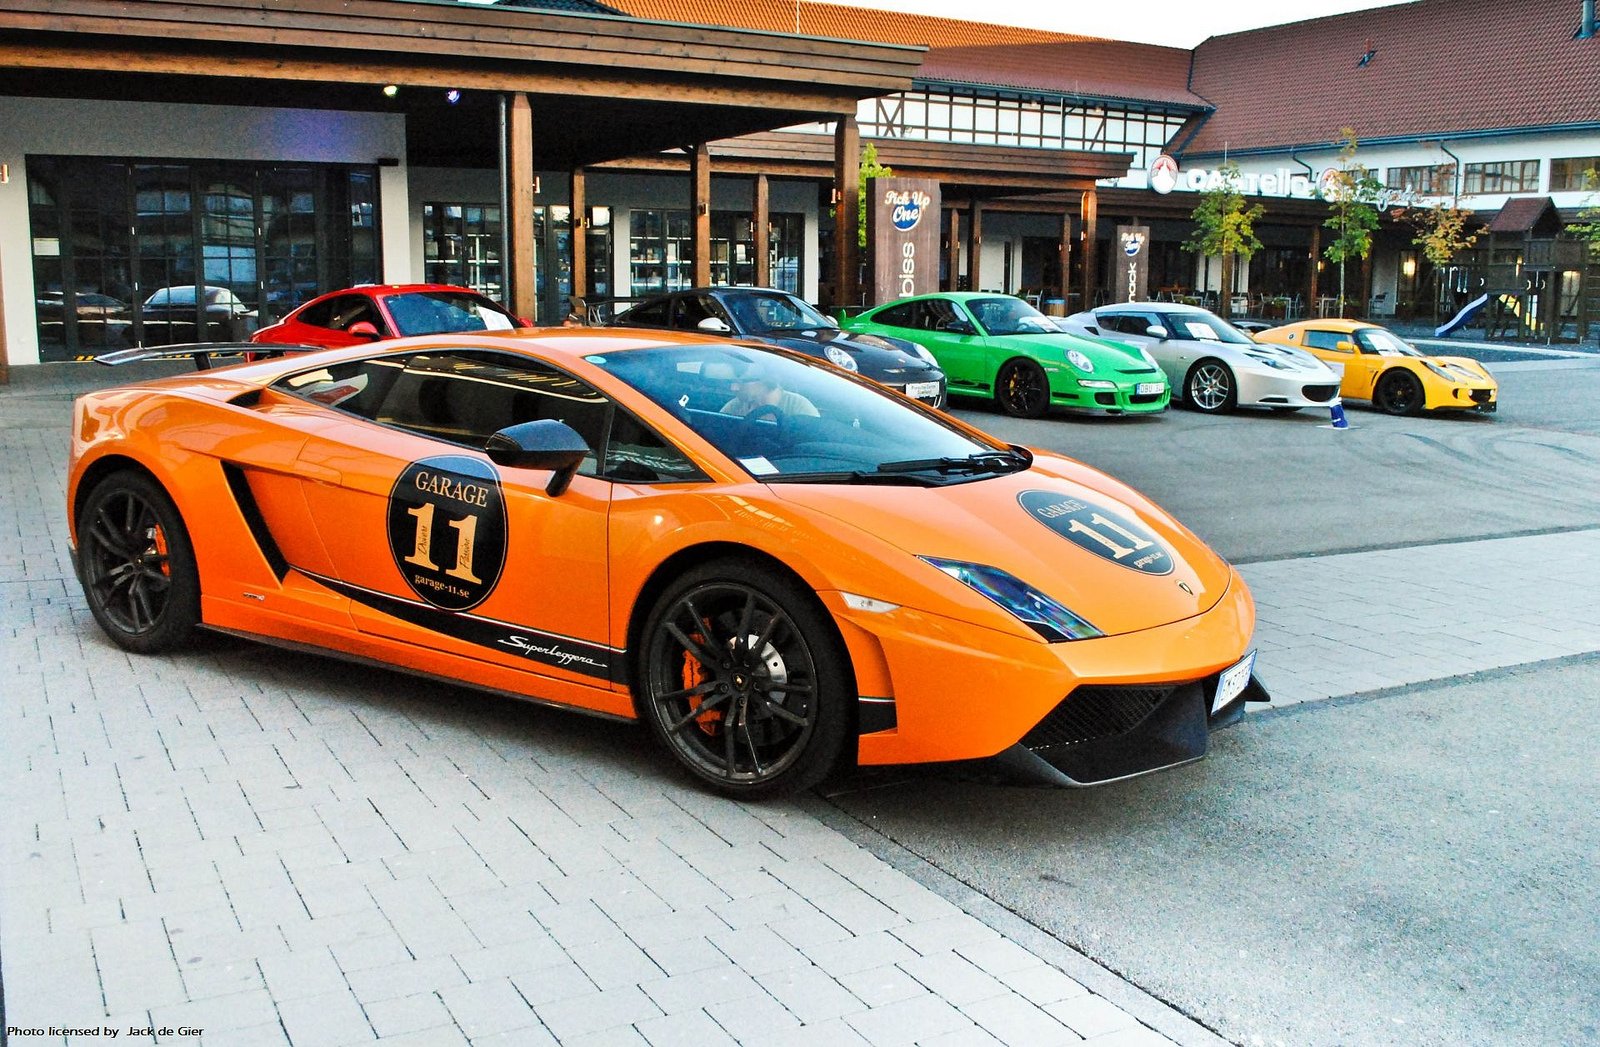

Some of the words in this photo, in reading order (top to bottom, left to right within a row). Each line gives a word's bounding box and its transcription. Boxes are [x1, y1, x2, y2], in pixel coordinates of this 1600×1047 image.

[885, 190, 910, 205] Pick
[911, 190, 931, 210] Up
[892, 205, 920, 223] One
[415, 471, 489, 508] GARAGE
[1036, 499, 1088, 519] GARAGE
[404, 502, 482, 585] 11
[1068, 512, 1155, 560] 11
[414, 574, 470, 599] garage-11.se
[497, 635, 608, 668] Superleggera
